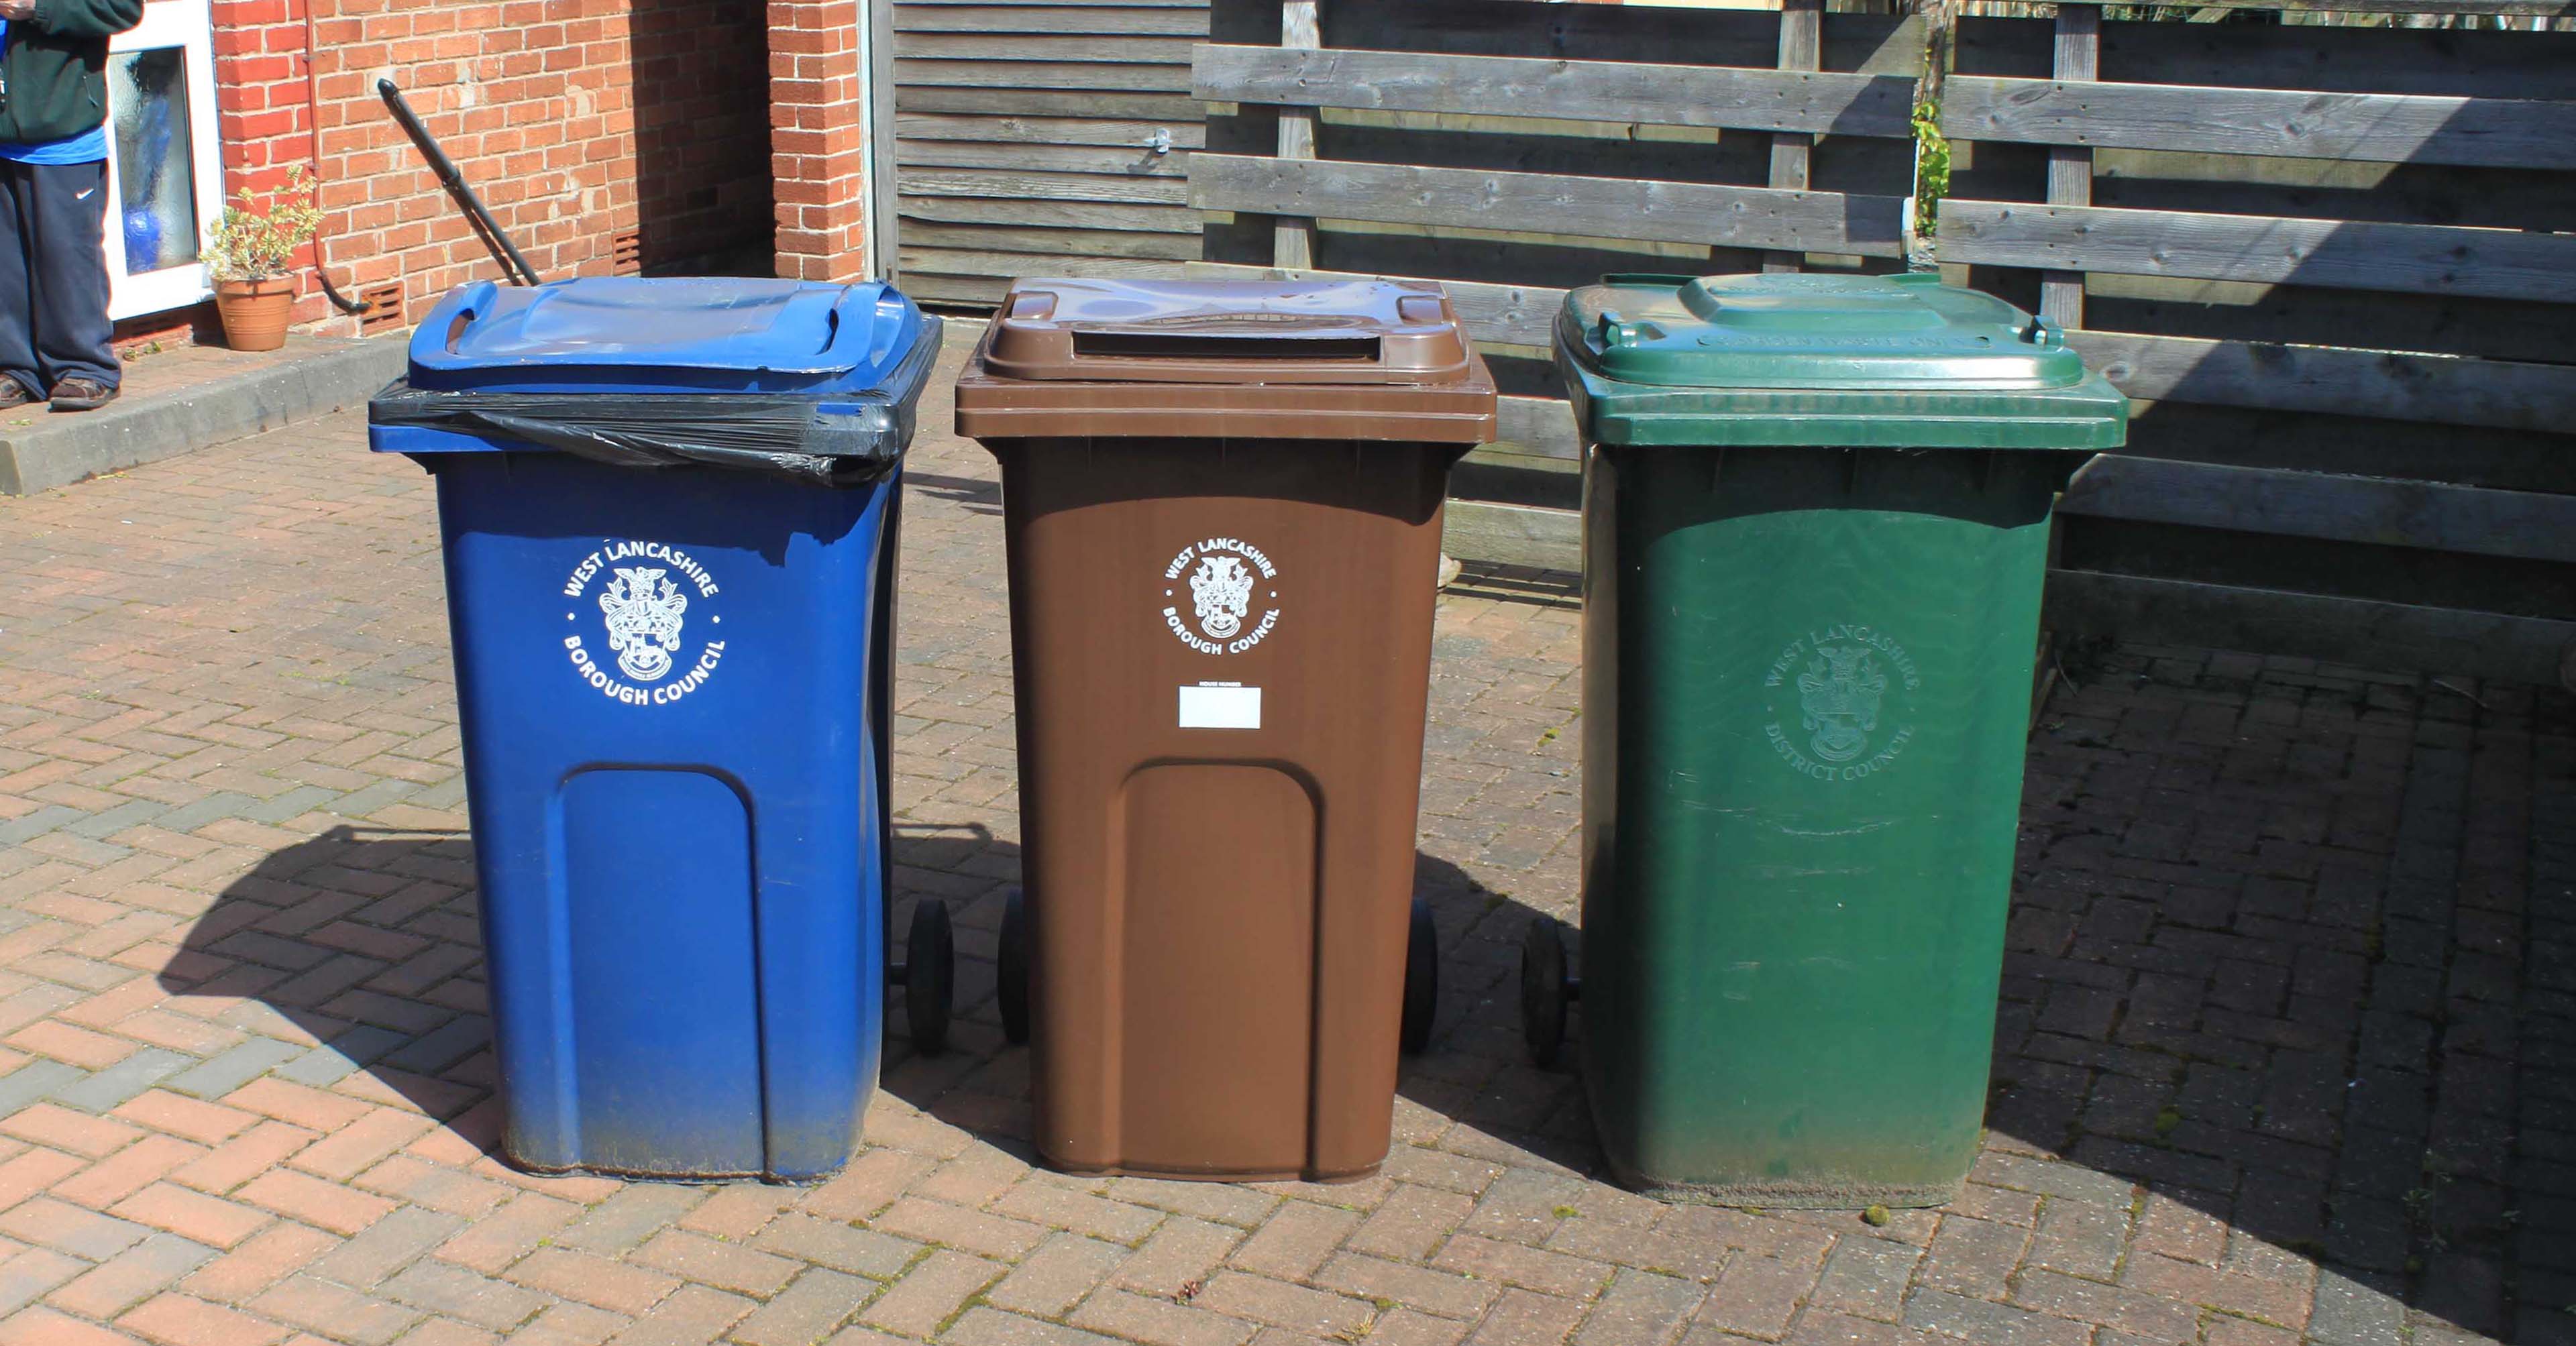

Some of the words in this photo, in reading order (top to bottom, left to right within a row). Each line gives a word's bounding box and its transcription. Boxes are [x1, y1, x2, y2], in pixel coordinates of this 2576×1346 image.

[564, 552, 604, 597] WEST
[604, 540, 719, 598] LANCASHIRE
[1165, 547, 1195, 579] WEST
[1197, 538, 1276, 579] LANCASHIRE
[1163, 606, 1222, 655] BOROUGH
[1229, 608, 1280, 653] COUNCIL
[1765, 638, 1806, 687] WEST
[1810, 624, 1921, 691] LANCASHIRE
[564, 635, 649, 705] BOROUGH
[653, 639, 725, 704] COUNCIL
[1765, 724, 1837, 781] DISTRICT
[1842, 725, 1915, 781] COUNCIL
